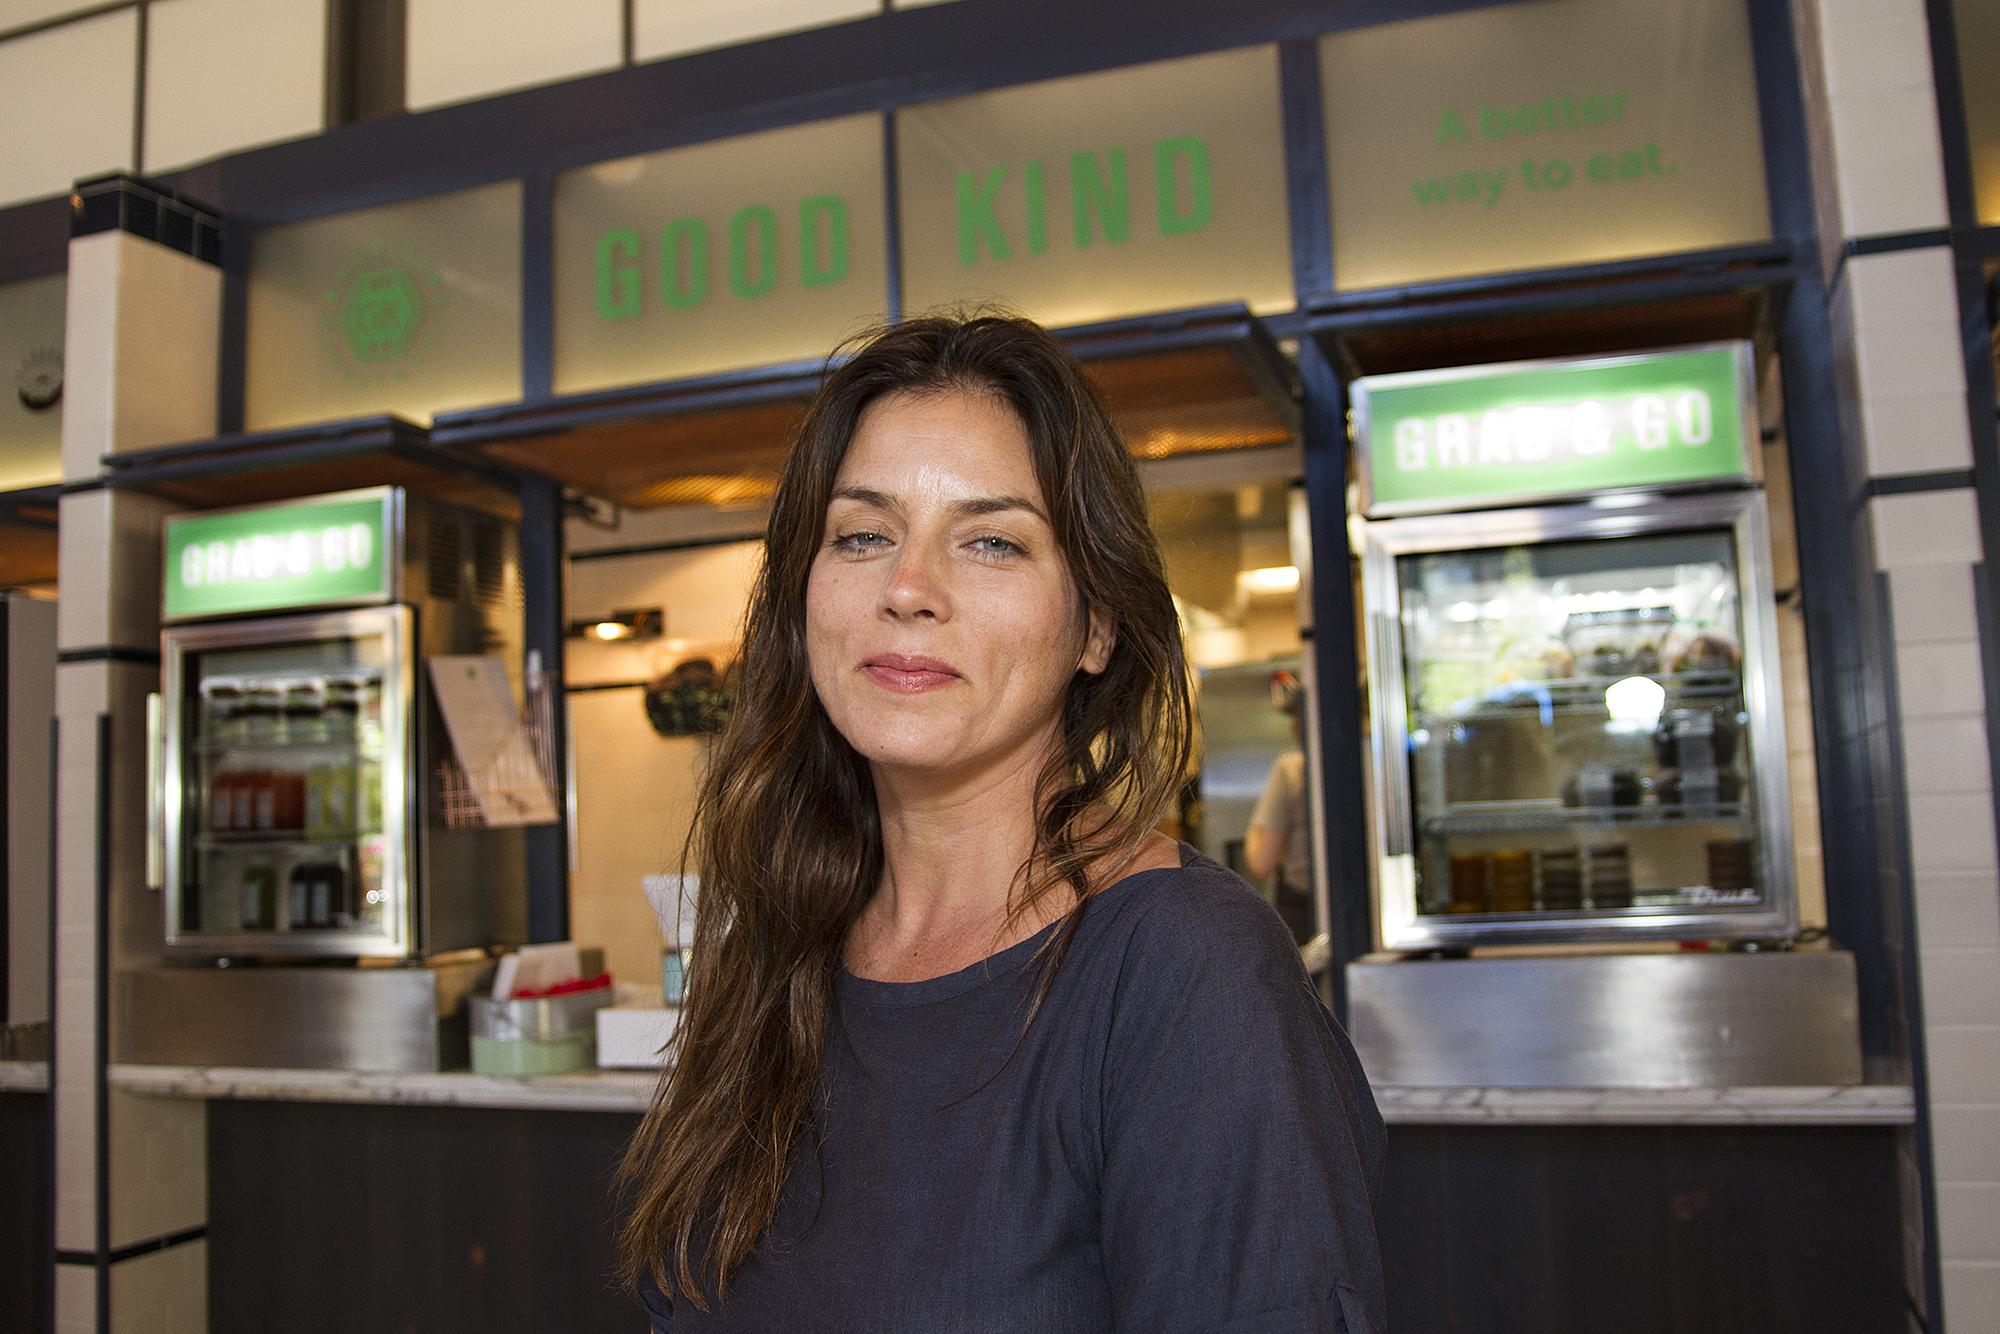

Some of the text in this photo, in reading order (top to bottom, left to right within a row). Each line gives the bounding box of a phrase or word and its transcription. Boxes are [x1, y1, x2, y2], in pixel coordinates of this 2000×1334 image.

[1436, 91, 1628, 143] A better
[1412, 141, 1678, 207] way to eat.
[595, 193, 848, 320] GOOD
[955, 135, 1212, 265] KIND
[1631, 389, 1712, 450] GO
[322, 522, 372, 572] GO
